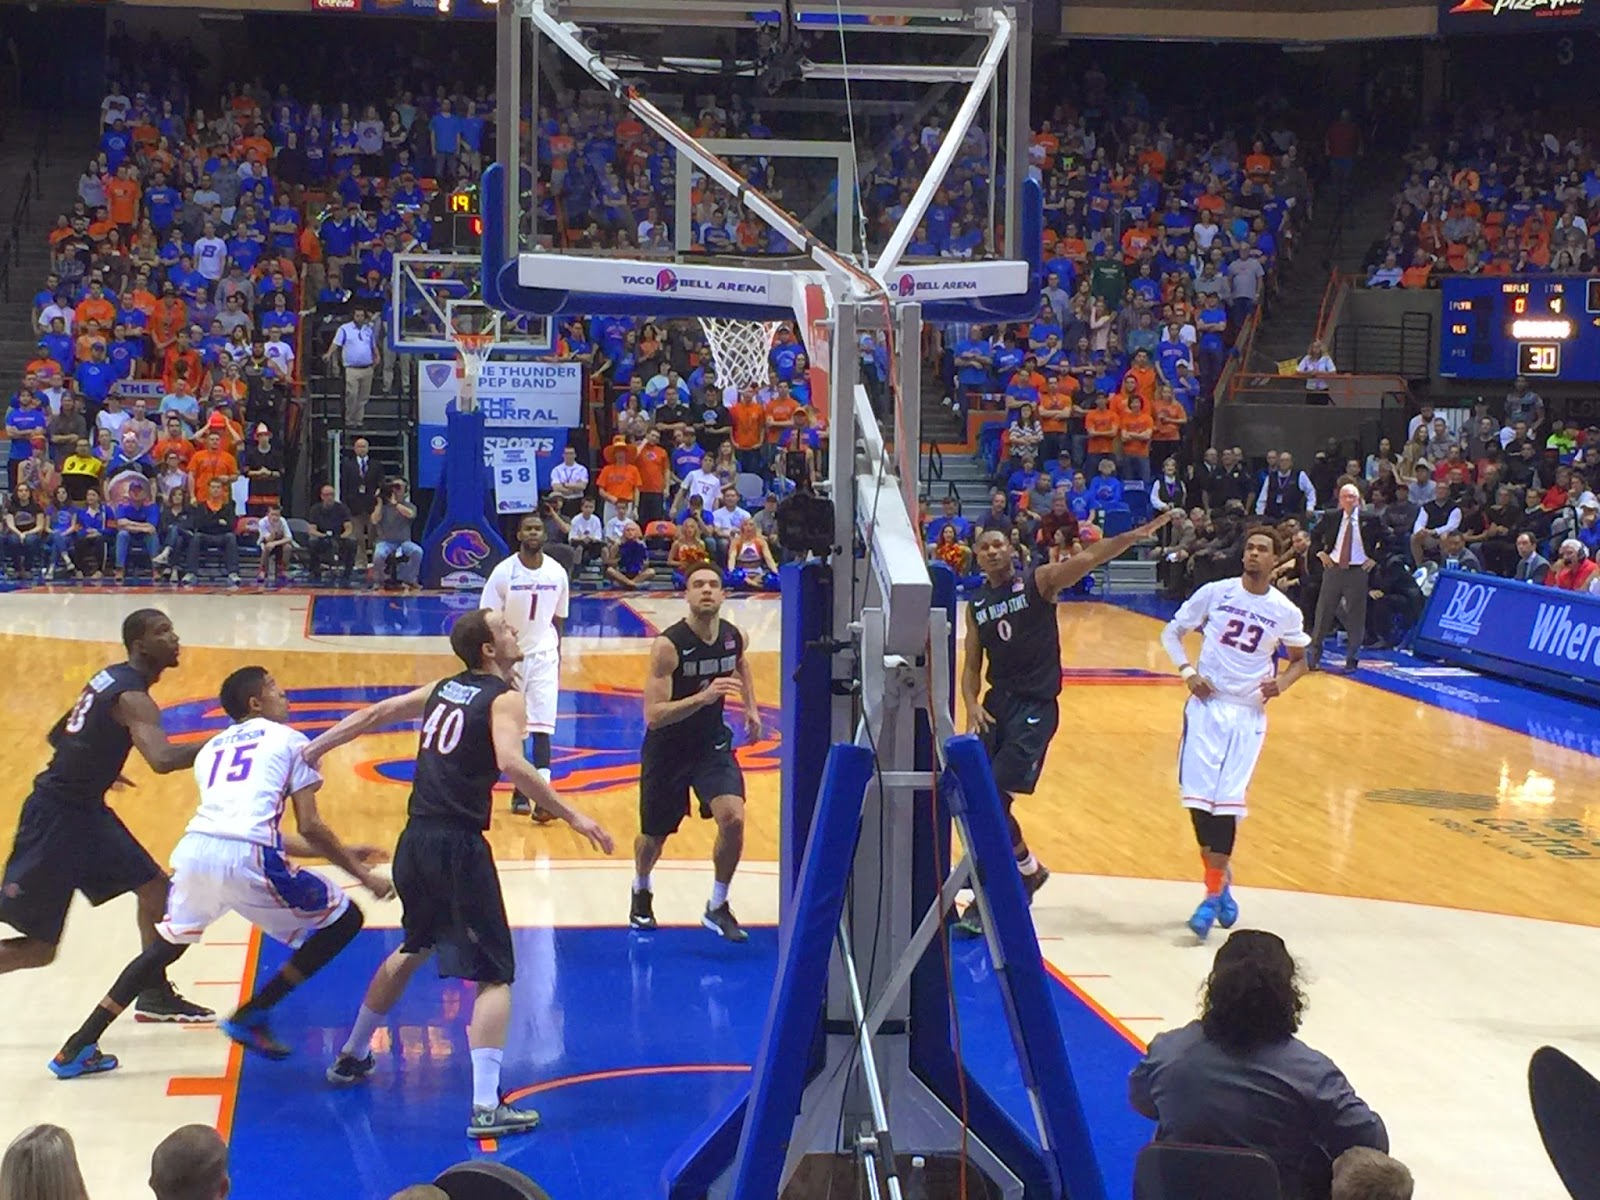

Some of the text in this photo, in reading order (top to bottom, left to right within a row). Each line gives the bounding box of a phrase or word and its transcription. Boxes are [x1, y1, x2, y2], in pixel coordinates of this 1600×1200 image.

[452, 195, 469, 211] 19
[621, 275, 767, 294] TACO BELL ARENA
[916, 281, 939, 290] BELL
[942, 281, 977, 290] ARENA
[1528, 347, 1556, 371] 30
[499, 366, 576, 378] THUNDER
[121, 384, 151, 394] THE
[478, 378, 557, 389] PEP BAND
[477, 397, 516, 410] THE
[483, 437, 554, 454] SPORTS
[529, 593, 538, 621] 1
[1441, 580, 1497, 627] BOI
[997, 619, 1012, 641] 0
[1219, 619, 1264, 654] 23
[422, 702, 465, 755] 40
[207, 742, 259, 789] 15
